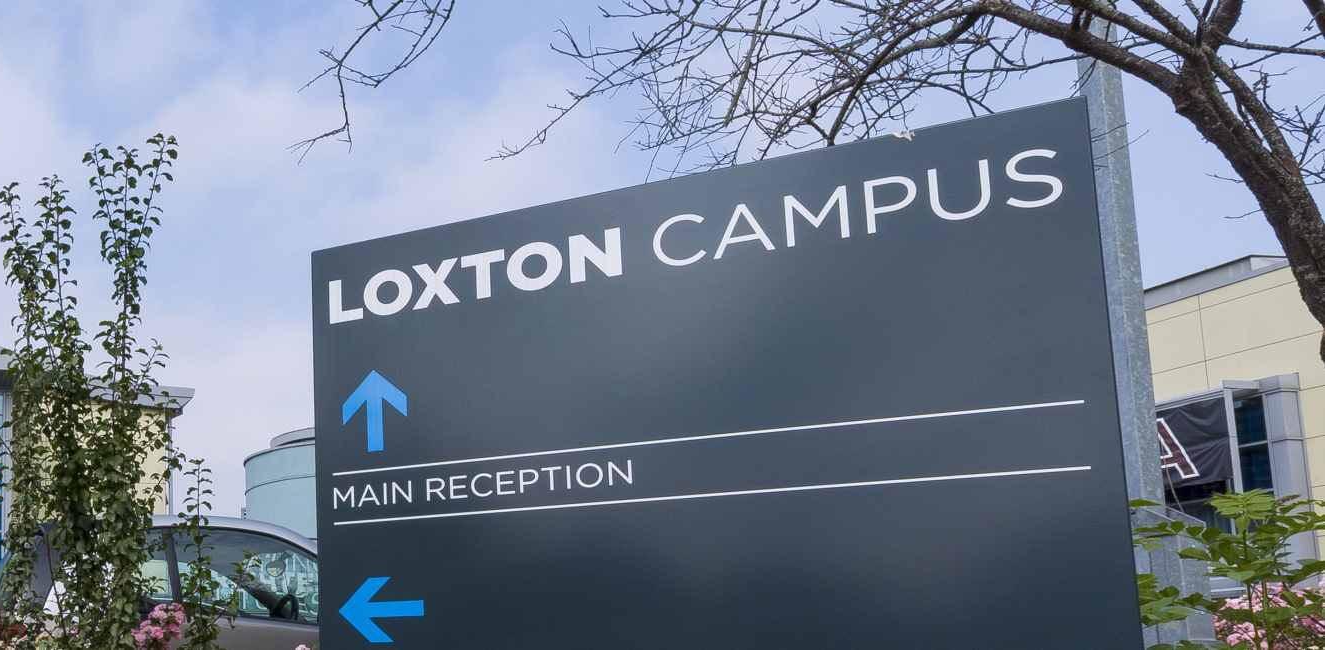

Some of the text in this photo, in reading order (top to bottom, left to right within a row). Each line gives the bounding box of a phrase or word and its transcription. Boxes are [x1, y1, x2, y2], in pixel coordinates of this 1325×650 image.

[328, 148, 1063, 325] LOXTON CAMPUS
[333, 459, 633, 510] MAIN RECEPTION
